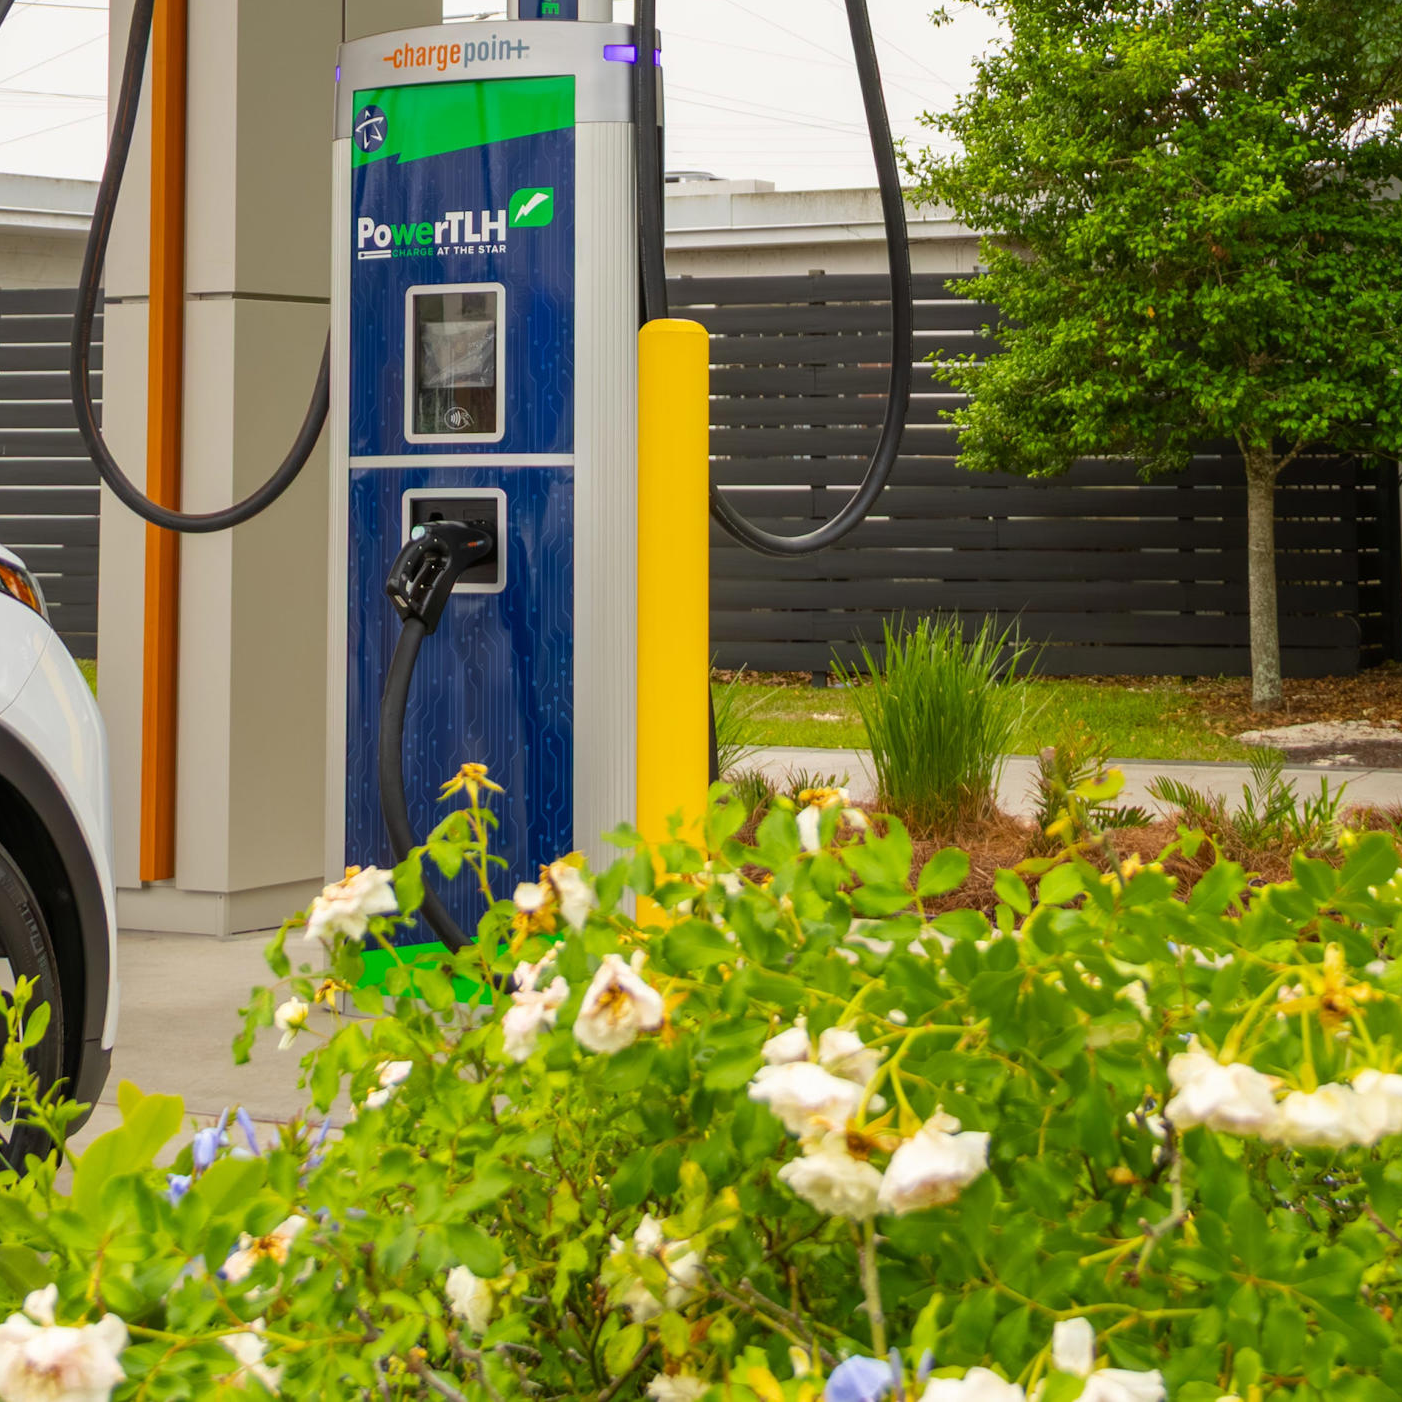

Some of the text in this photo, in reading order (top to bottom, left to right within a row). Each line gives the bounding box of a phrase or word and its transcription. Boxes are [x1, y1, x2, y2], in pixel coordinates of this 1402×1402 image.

[357, 210, 507, 249] PowerTLH
[391, 244, 507, 258] CHARGE AT THE STAR
